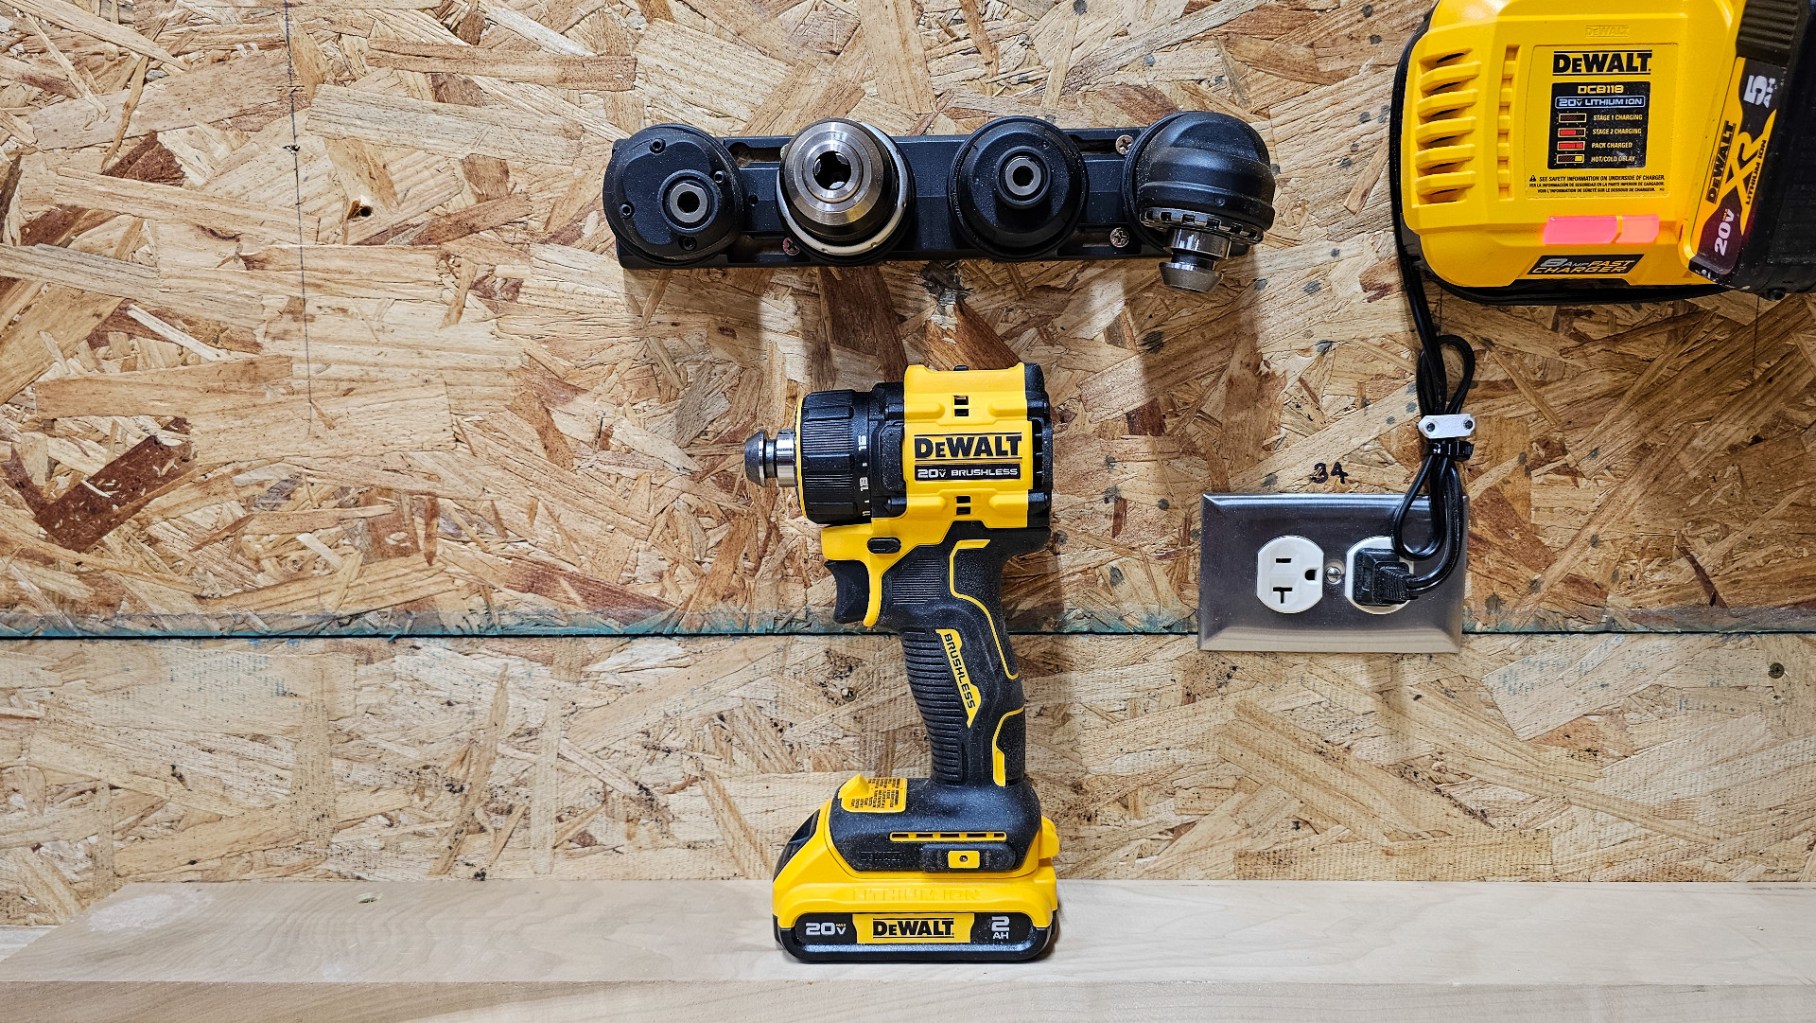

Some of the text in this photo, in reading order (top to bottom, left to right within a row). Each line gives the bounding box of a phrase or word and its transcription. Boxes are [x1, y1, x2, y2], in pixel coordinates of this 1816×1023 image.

[1552, 52, 1652, 73] DEWALT
[1577, 85, 1624, 94] DCB118
[1743, 75, 1767, 106] 5
[1763, 77, 1776, 108] AH
[1585, 98, 1624, 106] LITHIUM
[1706, 121, 1736, 204] DEWALT
[1746, 140, 1767, 205] LITHIUM ION
[1714, 208, 1735, 256] 20V
[914, 435, 1022, 458] DEWALT
[917, 468, 946, 478] 20V
[951, 468, 1018, 477] BRUSHLESS
[1310, 462, 1349, 484] 34
[944, 633, 976, 709] BRUSHLESS
[805, 922, 846, 935] 20V
[873, 920, 954, 936] DEWALT
[991, 916, 1010, 931] 2
[992, 932, 1009, 940] AH
